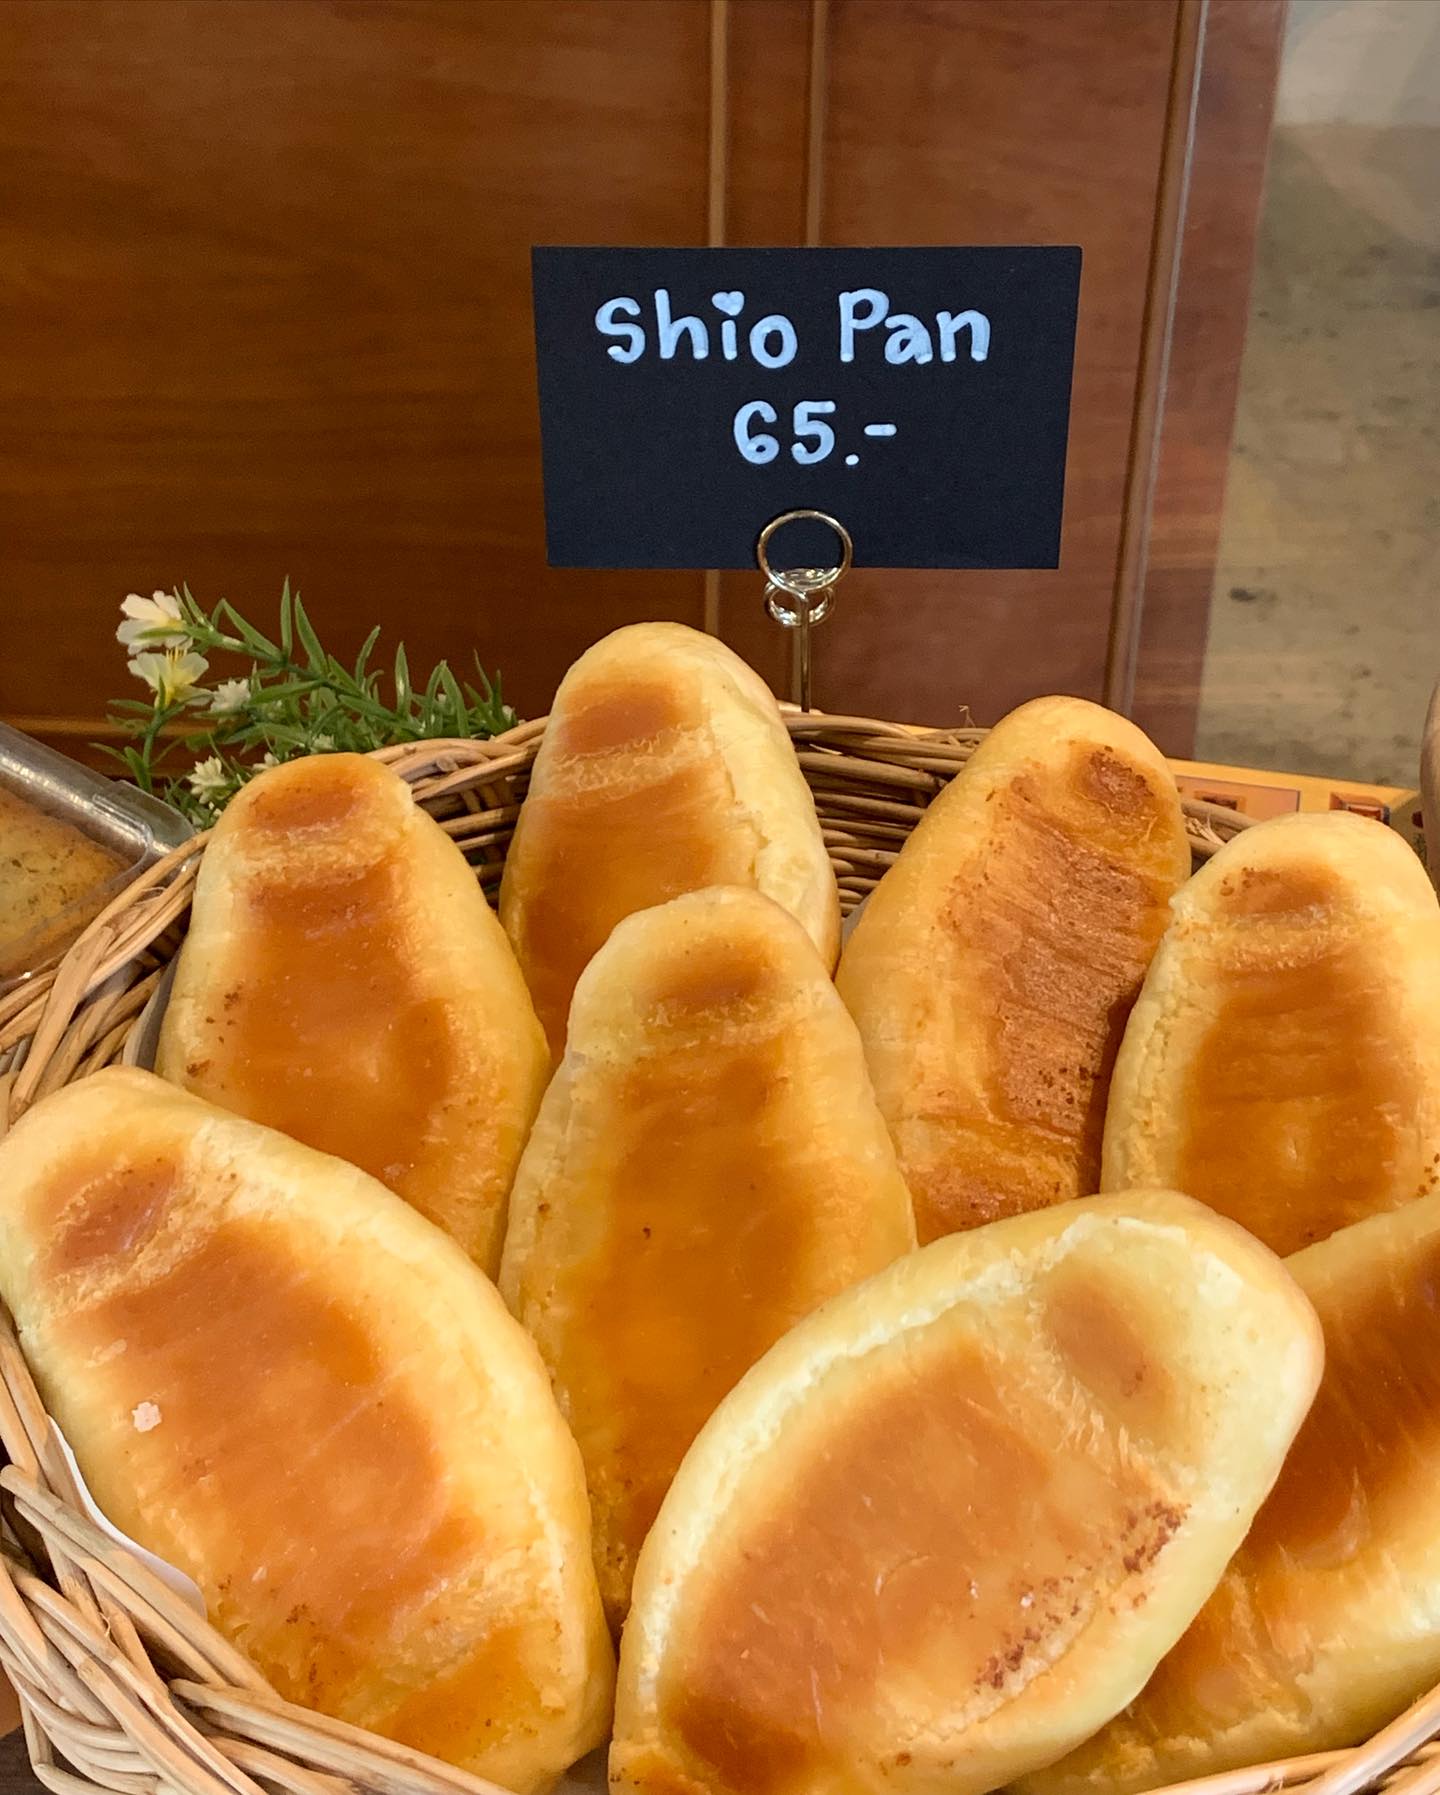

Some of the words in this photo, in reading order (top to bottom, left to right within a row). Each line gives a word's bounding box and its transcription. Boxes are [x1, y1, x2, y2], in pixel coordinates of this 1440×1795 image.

[594, 288, 798, 369] Shio
[838, 287, 991, 365] Pan
[732, 399, 897, 467] 65.-
